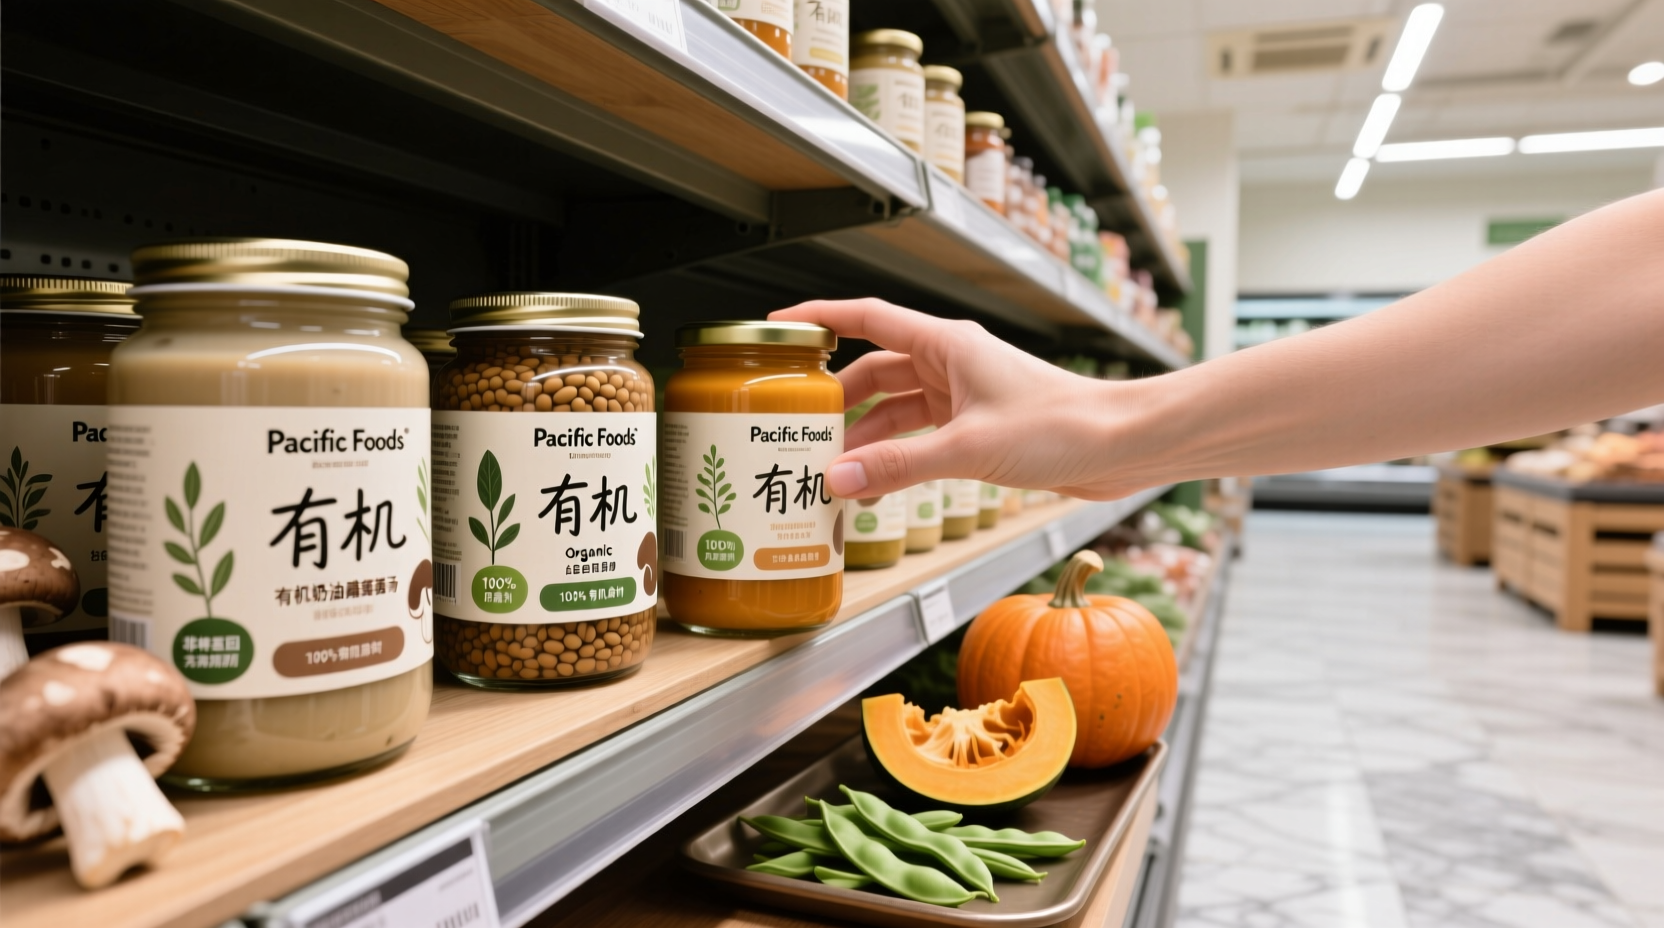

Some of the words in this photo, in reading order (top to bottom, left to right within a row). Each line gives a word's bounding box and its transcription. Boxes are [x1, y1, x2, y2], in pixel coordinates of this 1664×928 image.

[268, 428, 348, 454] Pacific
[534, 427, 594, 447] Pacific
[750, 425, 799, 443] Pacific
[753, 463, 832, 515] 有机
[538, 473, 638, 537] 有机
[269, 487, 407, 570] 有机
[565, 544, 613, 562] Organic
